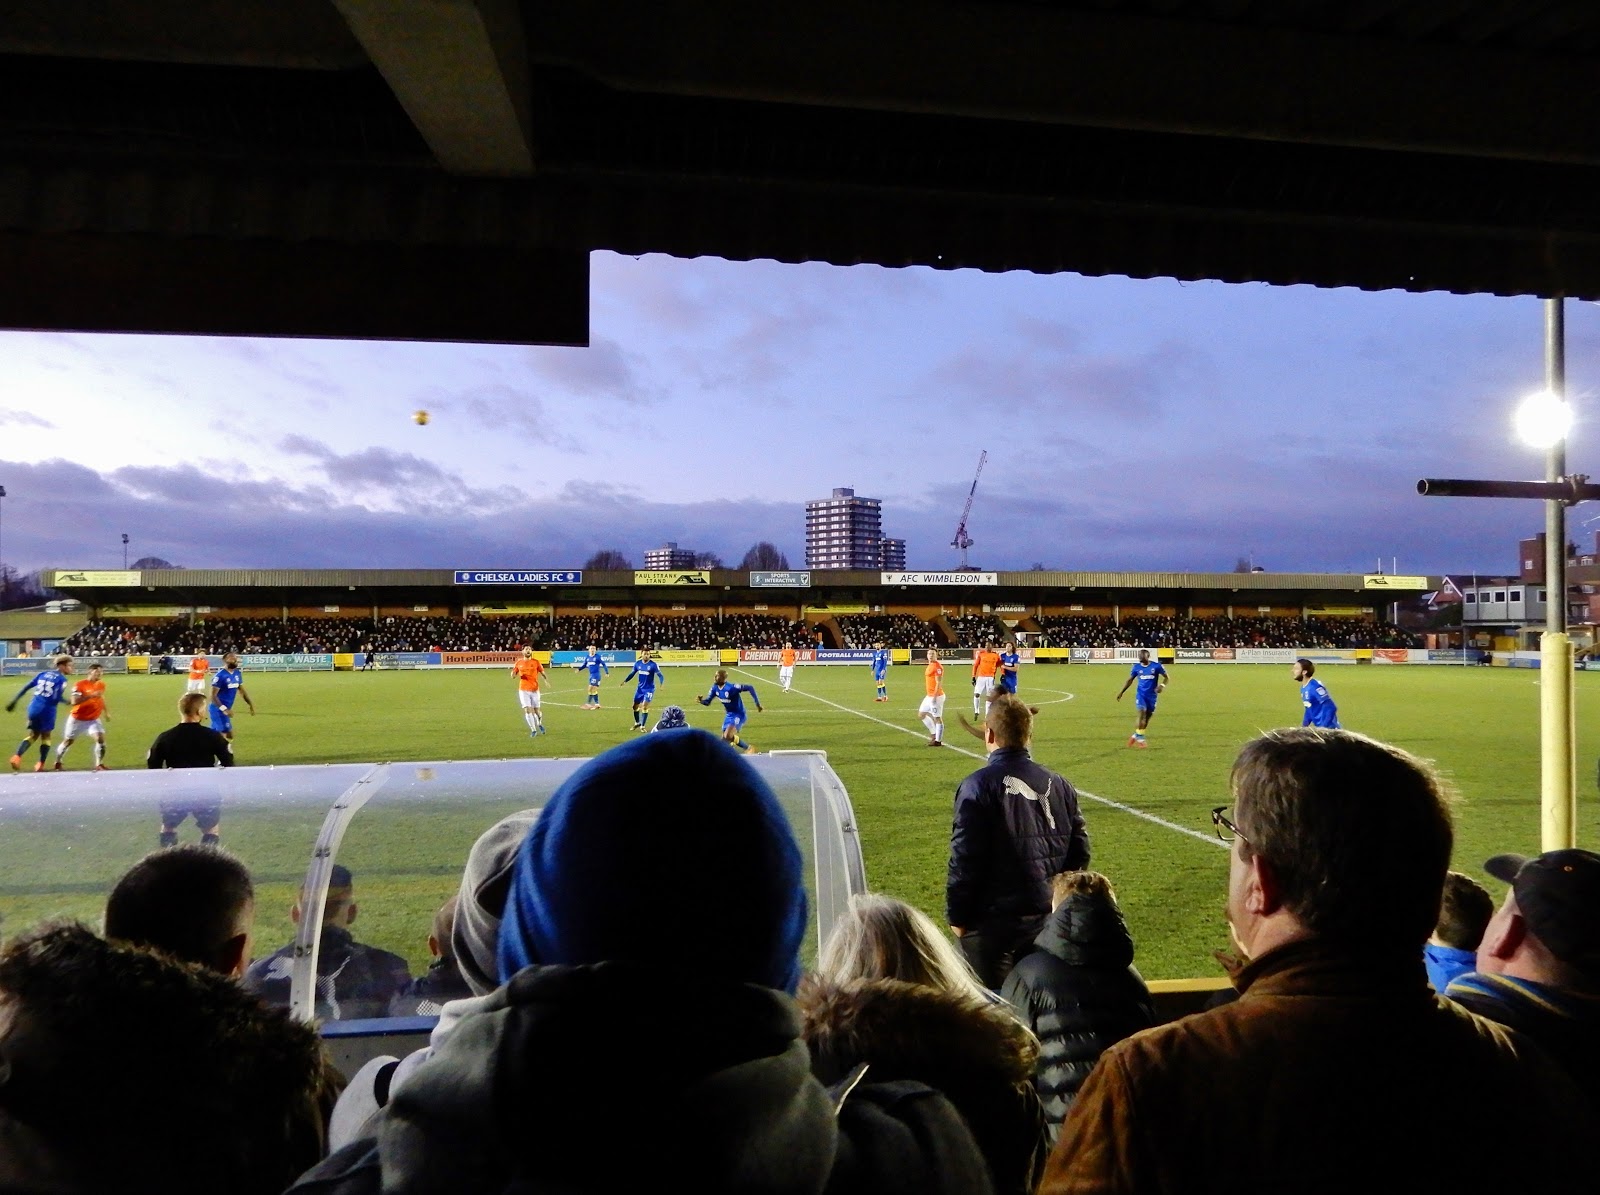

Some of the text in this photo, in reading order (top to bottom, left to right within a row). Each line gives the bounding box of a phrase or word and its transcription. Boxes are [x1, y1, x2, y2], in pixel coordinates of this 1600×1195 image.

[474, 574, 564, 582] CHELSEA LADIES FC
[900, 574, 980, 582] AFC WIMBLEDON
[744, 650, 812, 660] CHERRYREO.UK
[1074, 650, 1090, 659] sky
